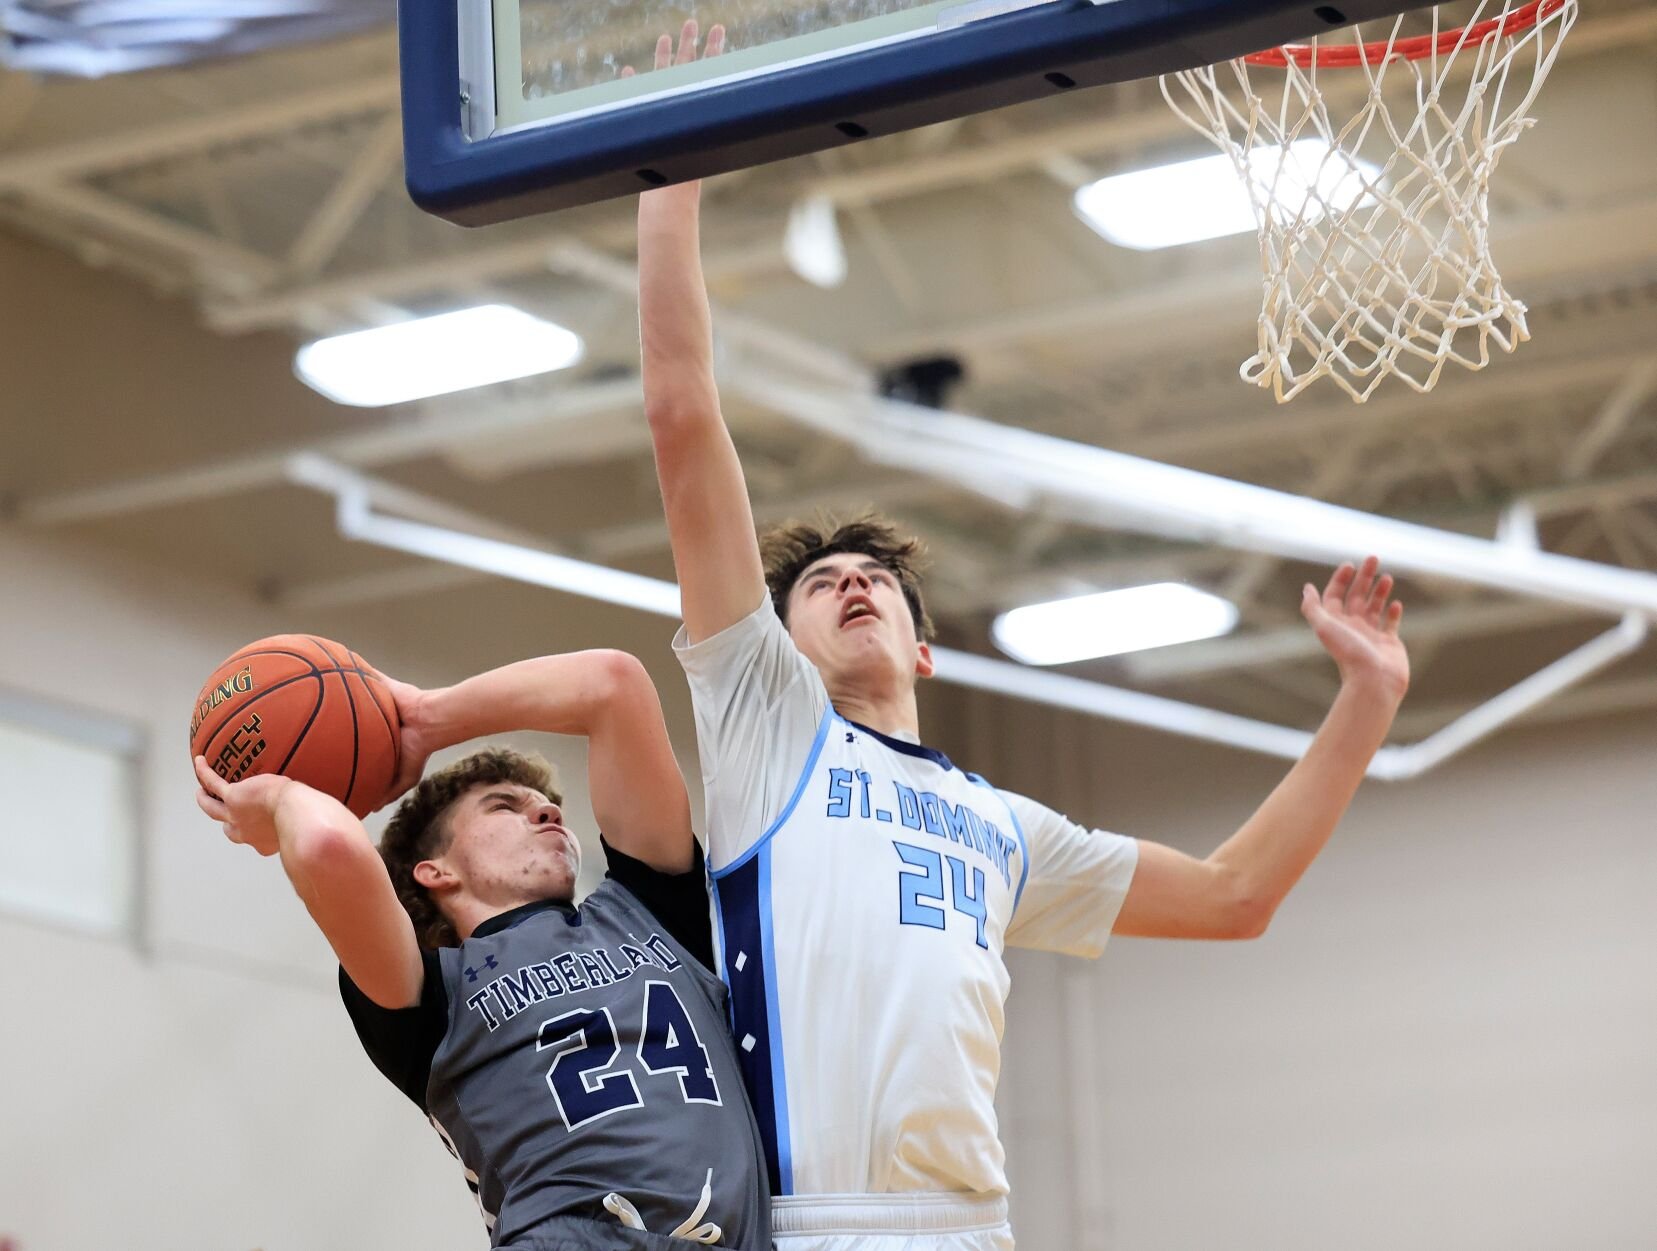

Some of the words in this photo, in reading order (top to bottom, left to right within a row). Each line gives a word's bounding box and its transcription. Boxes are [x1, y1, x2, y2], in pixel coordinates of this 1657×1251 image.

[212, 712, 263, 781] GACY
[229, 739, 267, 784] 000
[827, 768, 893, 823] ST.
[892, 840, 988, 950] 24
[466, 933, 682, 1032] TIMBERLAD
[536, 979, 723, 1132] 24
